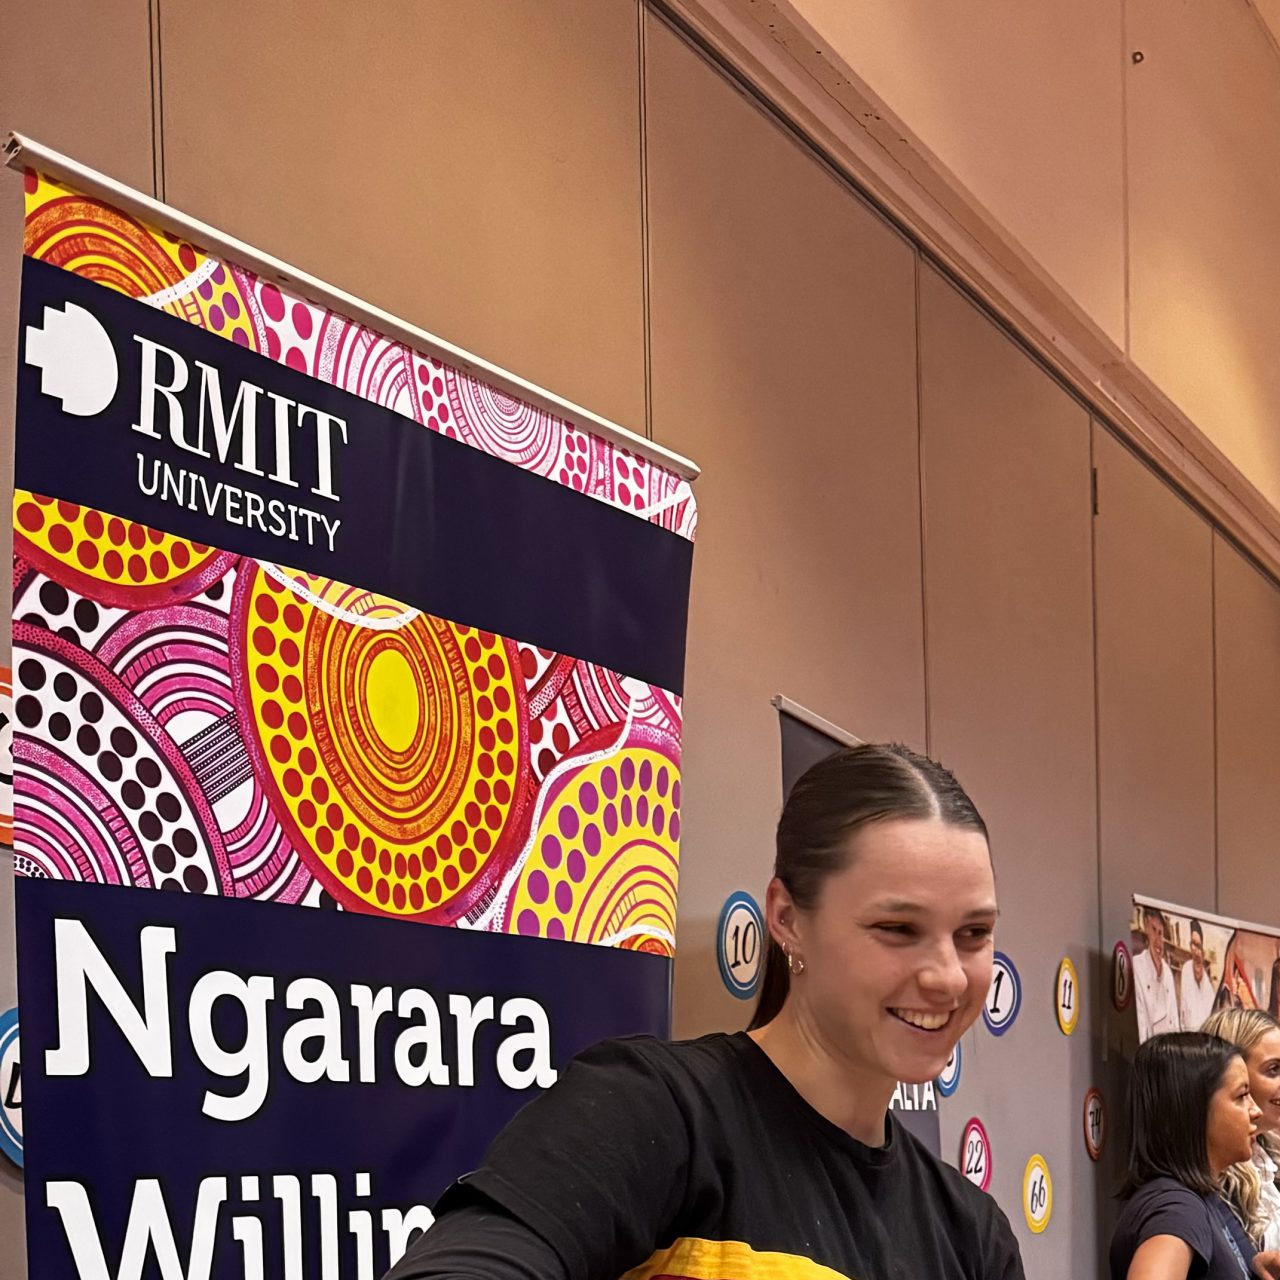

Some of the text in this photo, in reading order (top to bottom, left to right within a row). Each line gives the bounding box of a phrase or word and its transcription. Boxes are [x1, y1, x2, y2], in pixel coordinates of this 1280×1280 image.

[131, 333, 348, 502] RMIT
[136, 453, 342, 552] UNIVERSITY
[731, 921, 756, 968] 10
[1062, 978, 1073, 1009] 11
[45, 917, 558, 1121] Ngarara
[966, 1140, 983, 1174] 22
[1031, 1174, 1046, 1214] 66
